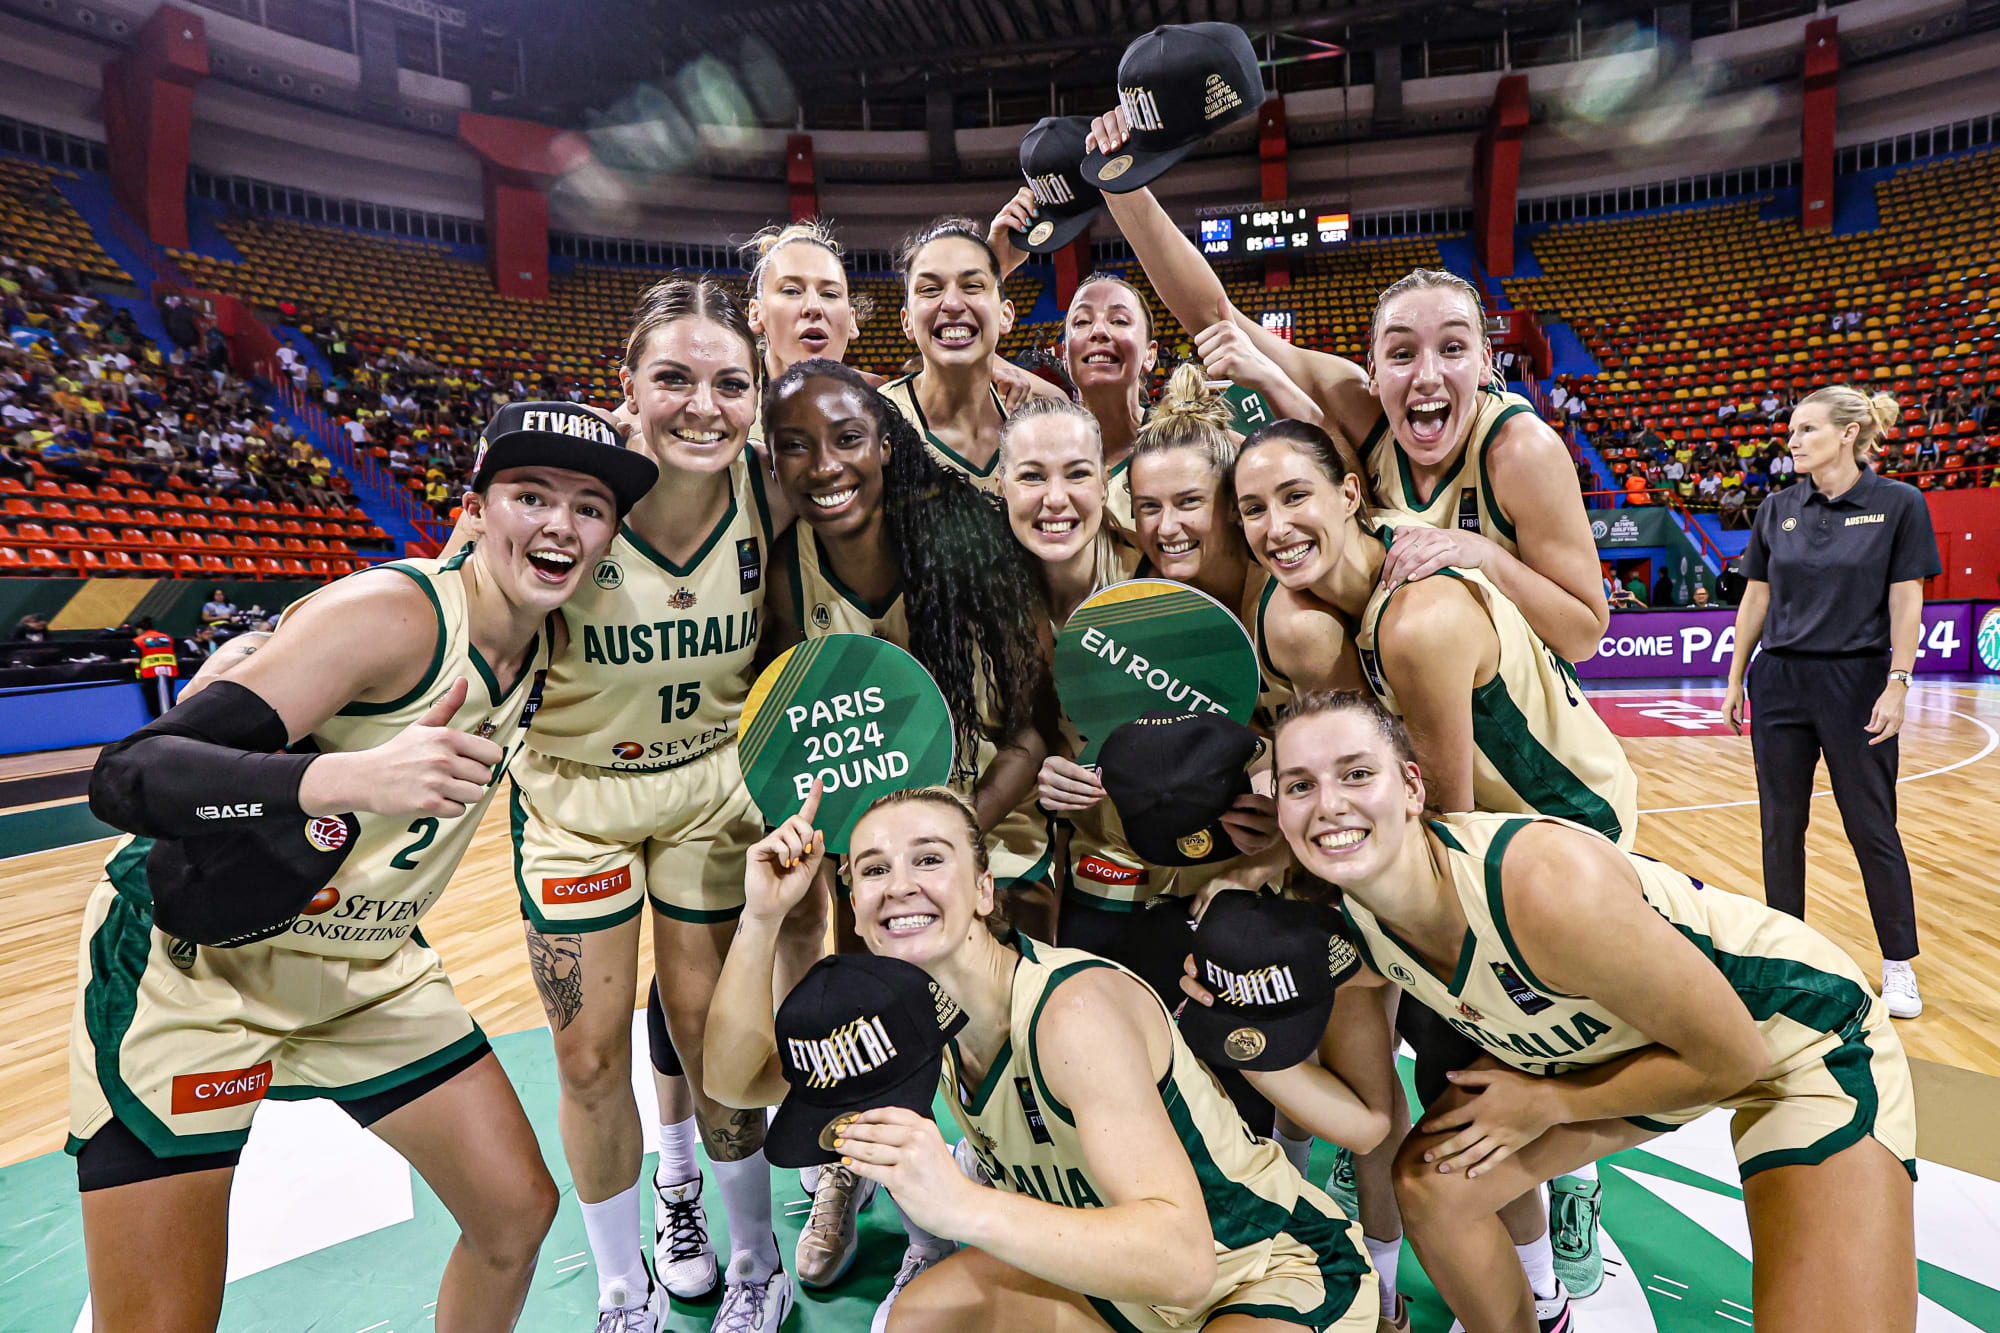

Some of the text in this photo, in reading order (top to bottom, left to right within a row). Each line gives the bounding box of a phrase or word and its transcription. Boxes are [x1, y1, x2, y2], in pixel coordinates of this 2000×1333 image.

[1205, 85, 1231, 104] OLYMPIC
[1205, 91, 1238, 114] QUALIFYING
[1204, 241, 1229, 253] AUS
[1320, 230, 1347, 243] GER
[1241, 392, 1266, 423] ET
[1844, 513, 1885, 527] AUSTRALIA
[743, 568, 759, 580] FIBA
[584, 608, 758, 665] AUSTRALIA
[1080, 627, 1127, 665] EN
[525, 703, 538, 713] FIB
[658, 681, 701, 724] 15
[786, 687, 885, 732] PARIS
[648, 716, 728, 759] SEVEN
[803, 721, 884, 764] 2024
[793, 751, 909, 800] BOUND
[196, 803, 264, 820] BASE
[390, 817, 439, 870] 2
[553, 873, 624, 896] CYGNETT
[333, 894, 427, 922] SEVEN
[292, 920, 409, 941] ONSULTING
[1513, 991, 1537, 1005] FIBA
[195, 1072, 266, 1098] CYGNETT
